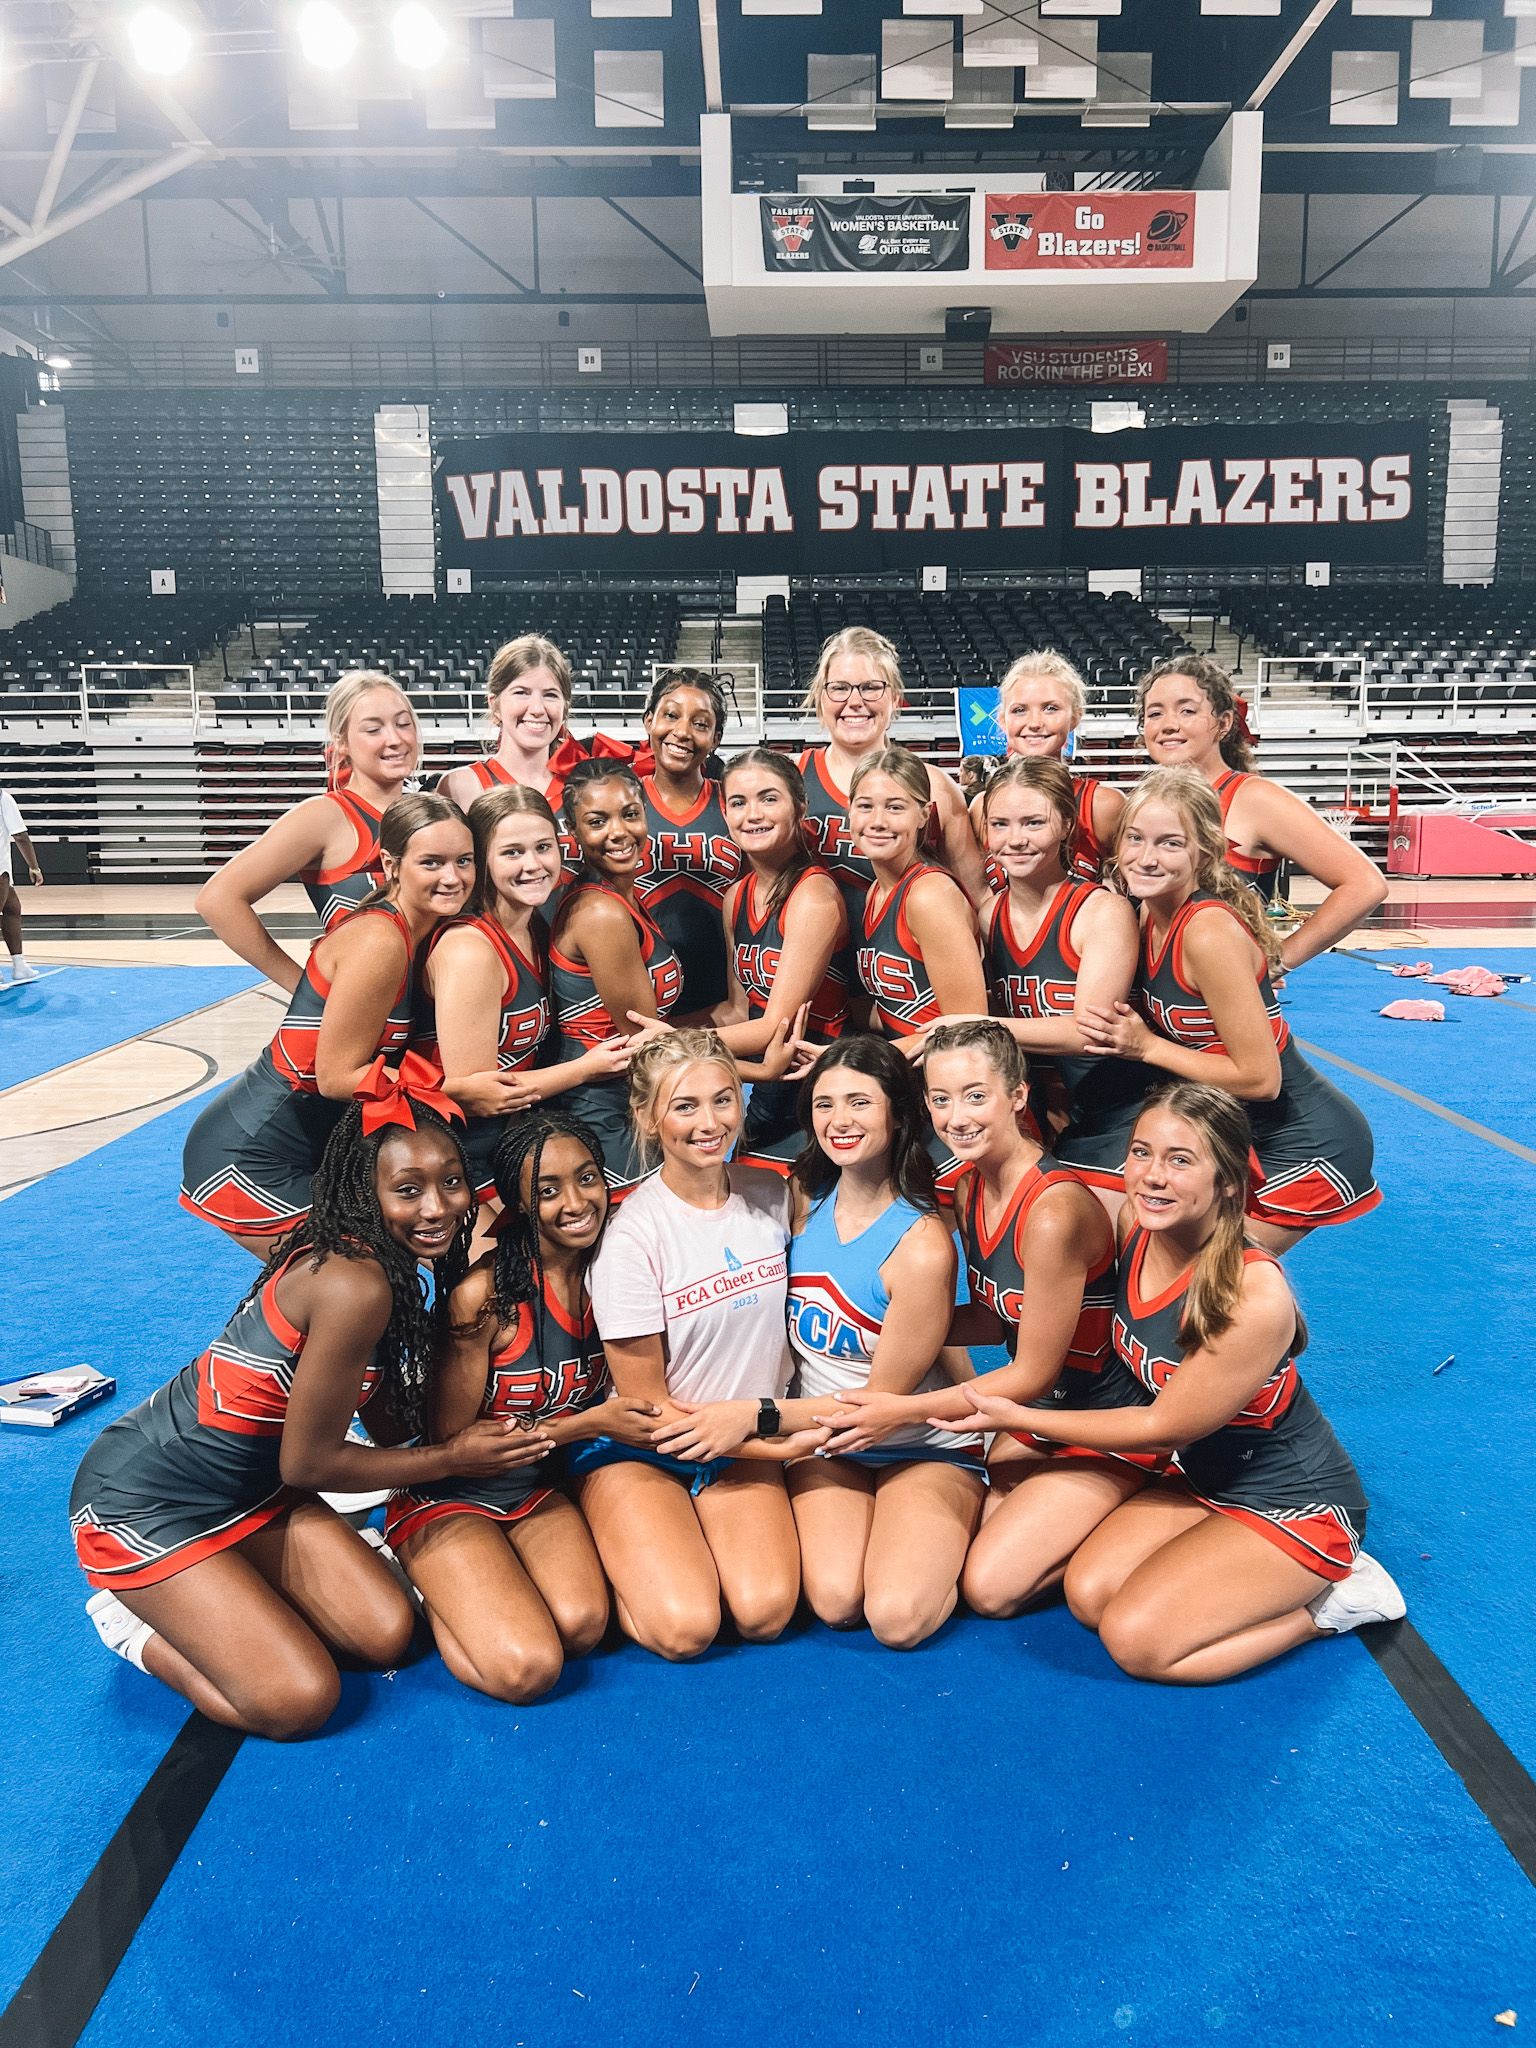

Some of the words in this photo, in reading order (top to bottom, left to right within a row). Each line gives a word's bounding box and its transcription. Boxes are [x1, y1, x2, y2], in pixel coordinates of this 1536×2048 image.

[829, 221, 885, 231] WOMEN'S
[887, 220, 960, 231] BASKETBALL
[1074, 206, 1105, 230] Go
[780, 227, 806, 236] STATE
[998, 225, 1025, 235] STATE
[879, 245, 900, 254] OUR
[1037, 232, 1141, 256] Blazers!
[241, 356, 253, 365] AA
[926, 355, 936, 364] CC
[1011, 351, 1045, 364] VSU
[1048, 349, 1139, 364] STUDENTS
[998, 365, 1067, 380] ROCKIN'
[1070, 365, 1103, 379] THE
[1107, 362, 1153, 377] PLEX!
[445, 466, 794, 541] VALDOSTA
[817, 461, 1047, 532] STATE
[1073, 453, 1412, 529] BLAZERS
[161, 578, 167, 586] A
[931, 575, 937, 584] C
[734, 943, 782, 988] HS
[857, 948, 920, 1004] HS
[996, 974, 1078, 1018] HS
[676, 1287, 711, 1310] FCA
[713, 1271, 756, 1295] Cheer
[733, 1294, 760, 1310] 2023
[483, 1352, 607, 1416] BH
